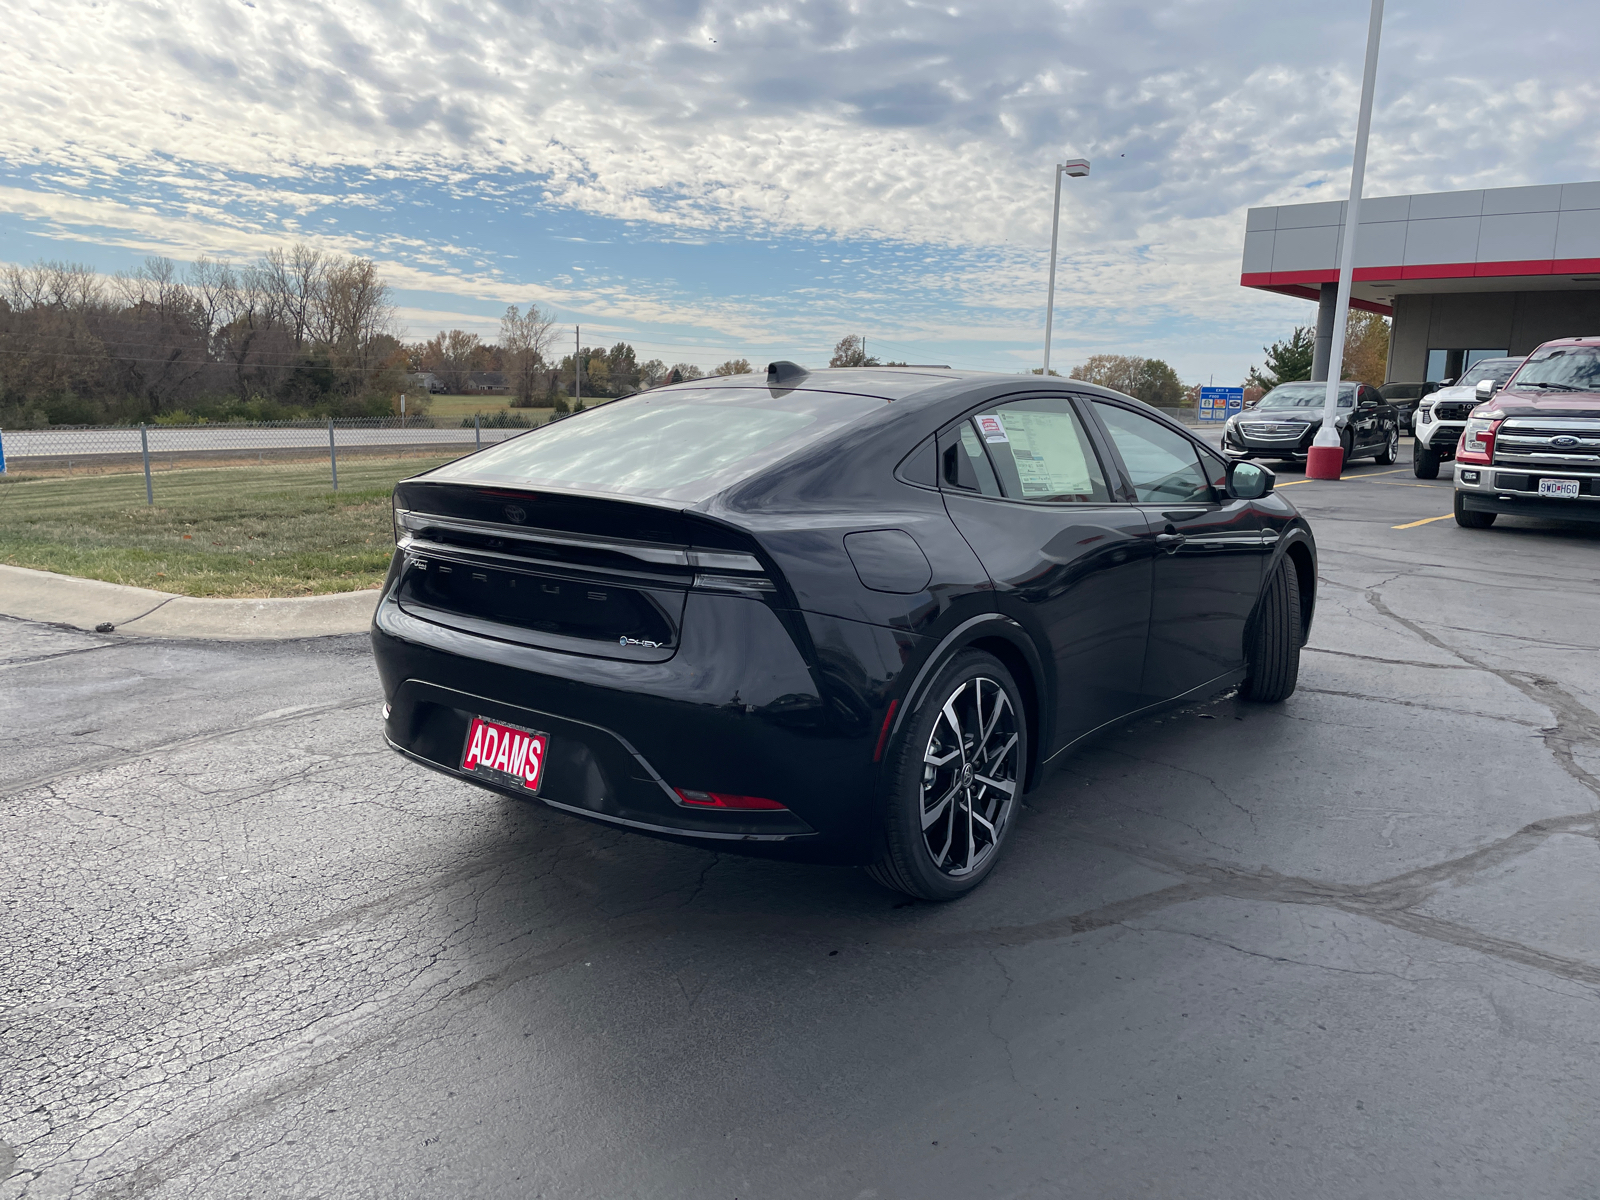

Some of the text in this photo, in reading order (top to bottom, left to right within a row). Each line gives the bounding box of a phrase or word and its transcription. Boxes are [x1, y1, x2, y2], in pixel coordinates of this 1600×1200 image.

[1555, 437, 1574, 446] Ford
[1540, 482, 1577, 494] 9WD H60
[439, 565, 608, 601] PRIUS
[626, 637, 664, 649] PHEV
[466, 724, 542, 782] ADAMS
